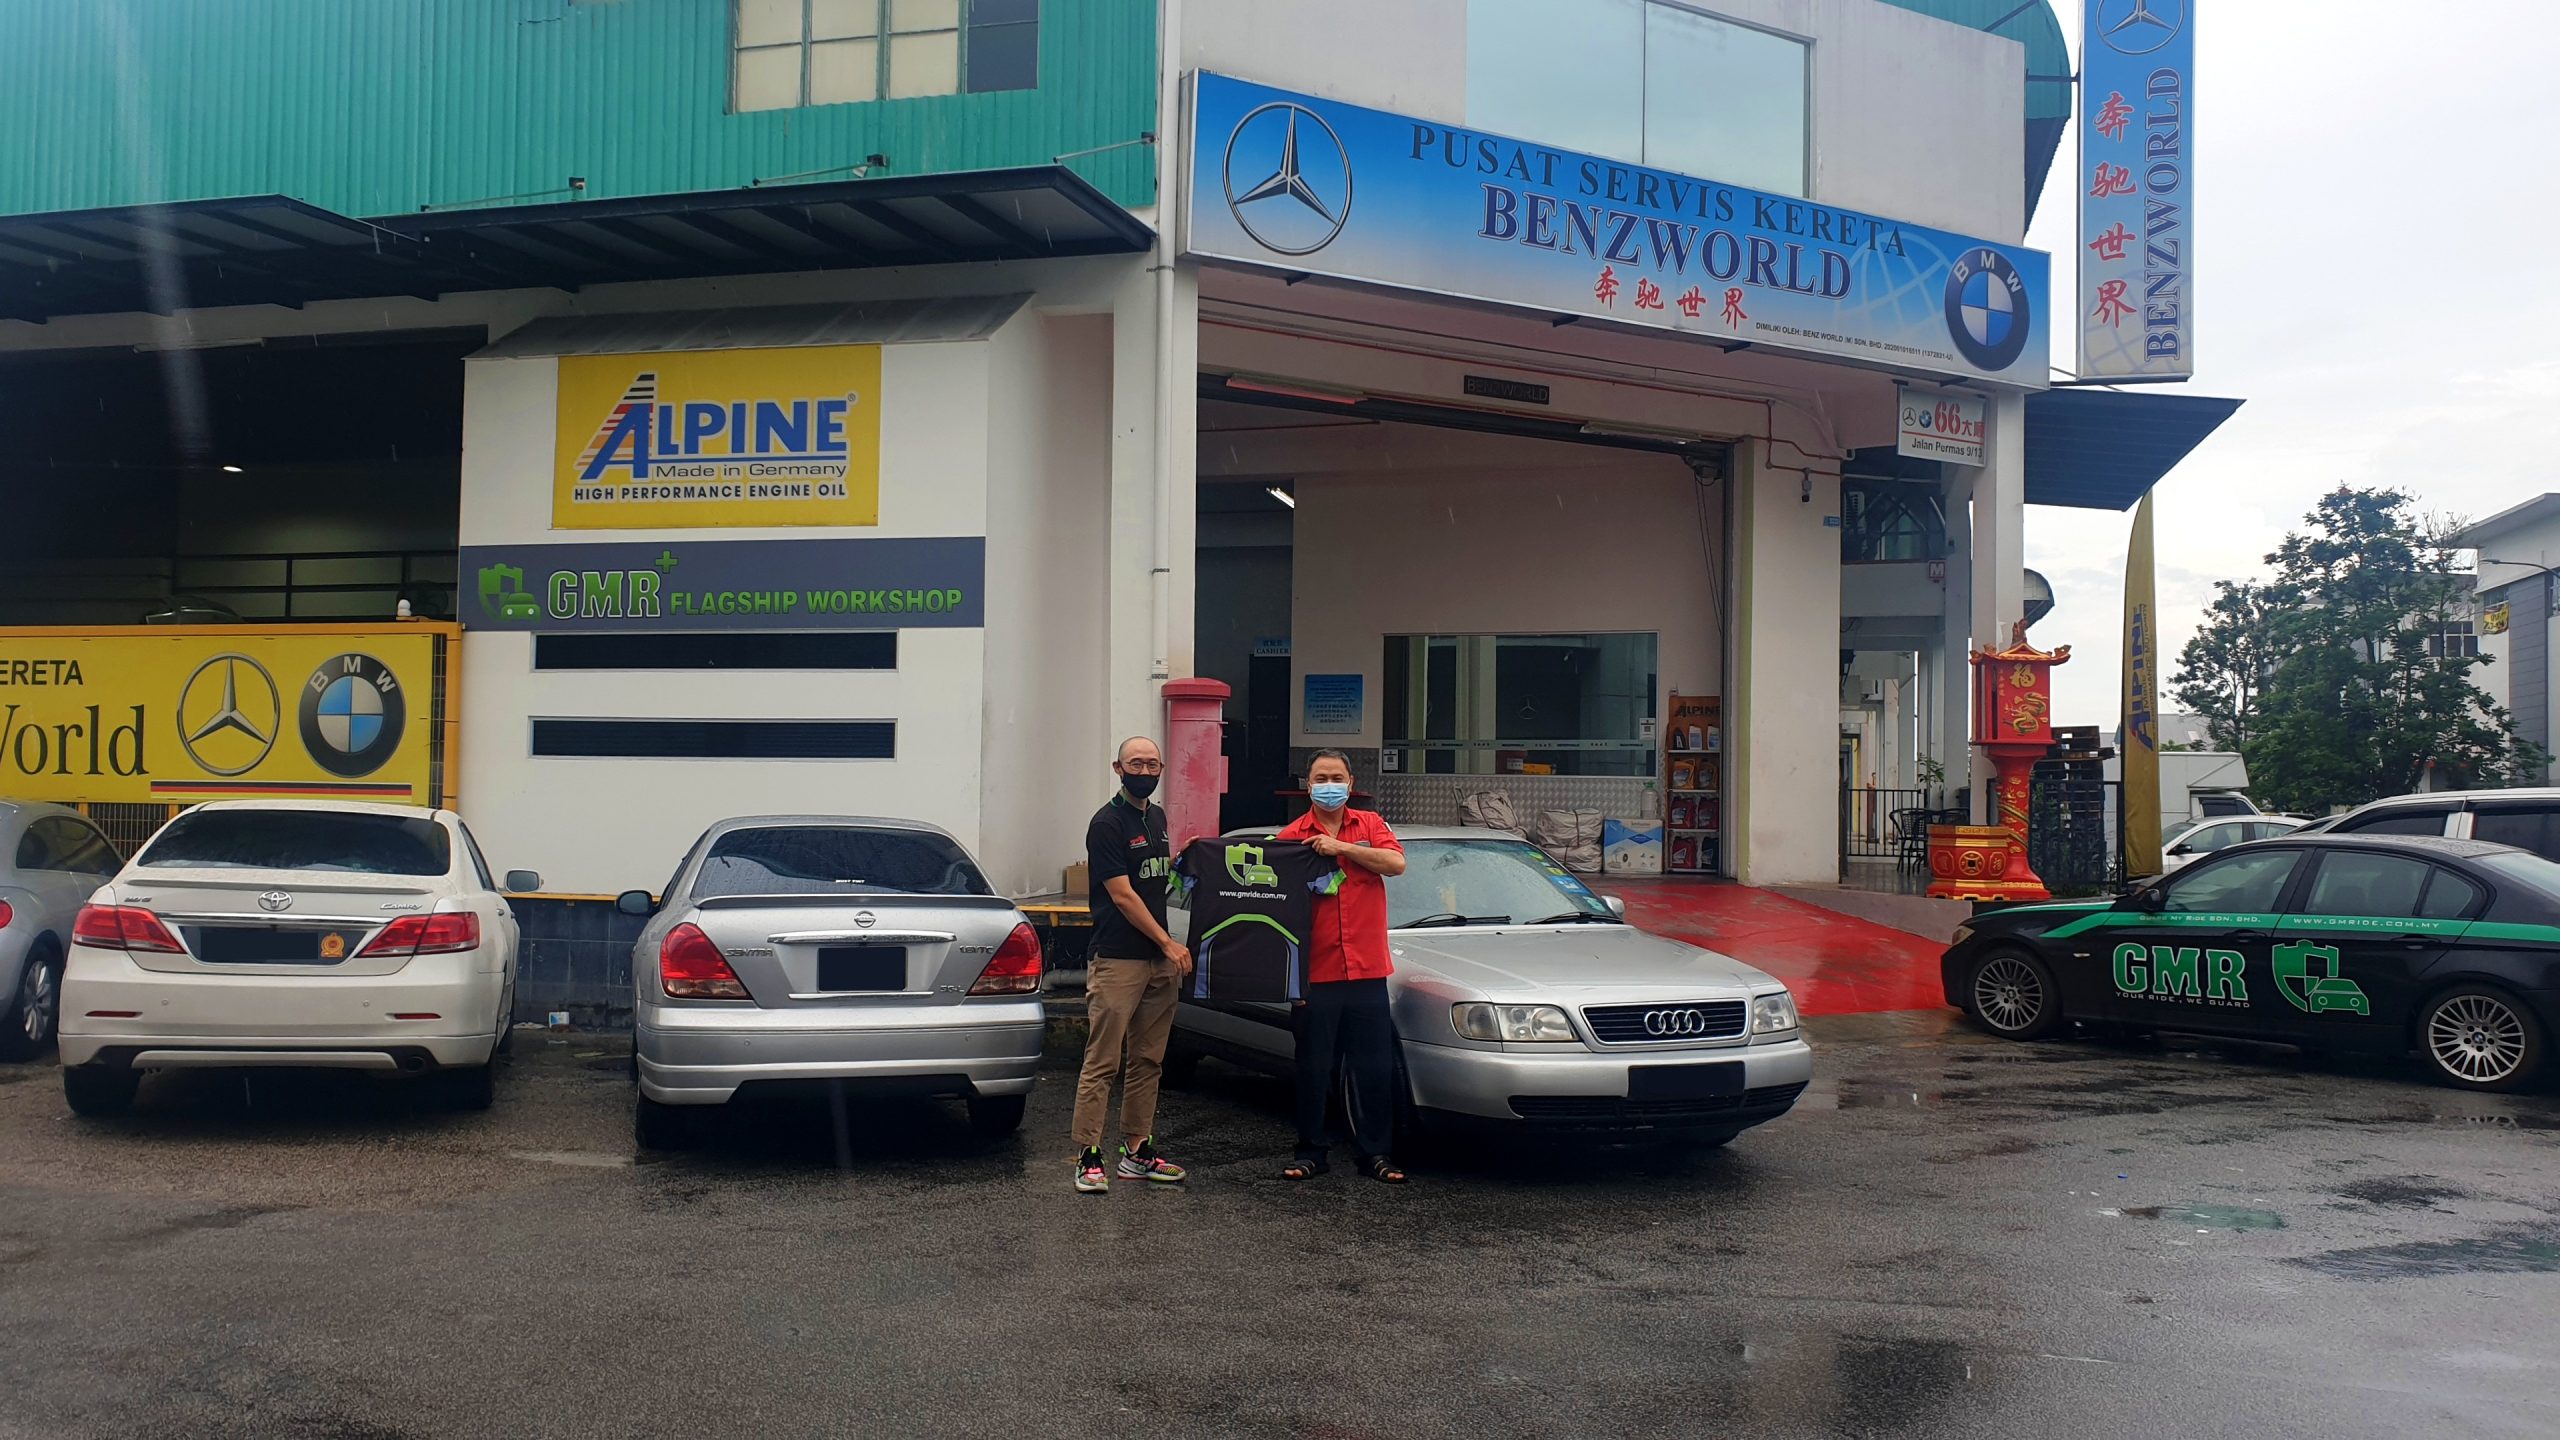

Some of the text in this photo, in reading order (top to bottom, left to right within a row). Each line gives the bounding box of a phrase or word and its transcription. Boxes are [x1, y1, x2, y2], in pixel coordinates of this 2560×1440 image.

[1409, 123, 1907, 257] PUSAT SERVIS KERETA
[2088, 92, 2137, 329] 奔驰世界
[2145, 66, 2182, 361] BENZWORLD
[1478, 182, 1853, 300] BENZWORLD
[1953, 249, 2023, 294] BMW
[1592, 264, 1750, 332] 奔驰世界
[1755, 321, 1781, 333] DIMILIKI
[1782, 325, 1801, 336] OLEH:
[1803, 329, 1820, 339] BENZ
[1821, 332, 1844, 343] WORLD
[579, 373, 847, 480] ALPINE
[1912, 438, 1933, 451] Jalan
[1936, 441, 1965, 456] Permas
[574, 484, 846, 501] HIGH PERFORMANCE ENGINE OIL
[656, 463, 847, 478] Made in Germany
[547, 569, 662, 619] GMR
[670, 588, 963, 615] FLAGSHIP WORKSHOP
[310, 654, 396, 694] BMW
[1219, 890, 1287, 901] www.gmride.com.my
[2113, 942, 2248, 1001] GMR
[2116, 991, 2144, 1000] YOUR
[2209, 1000, 2250, 1008] GUARD
